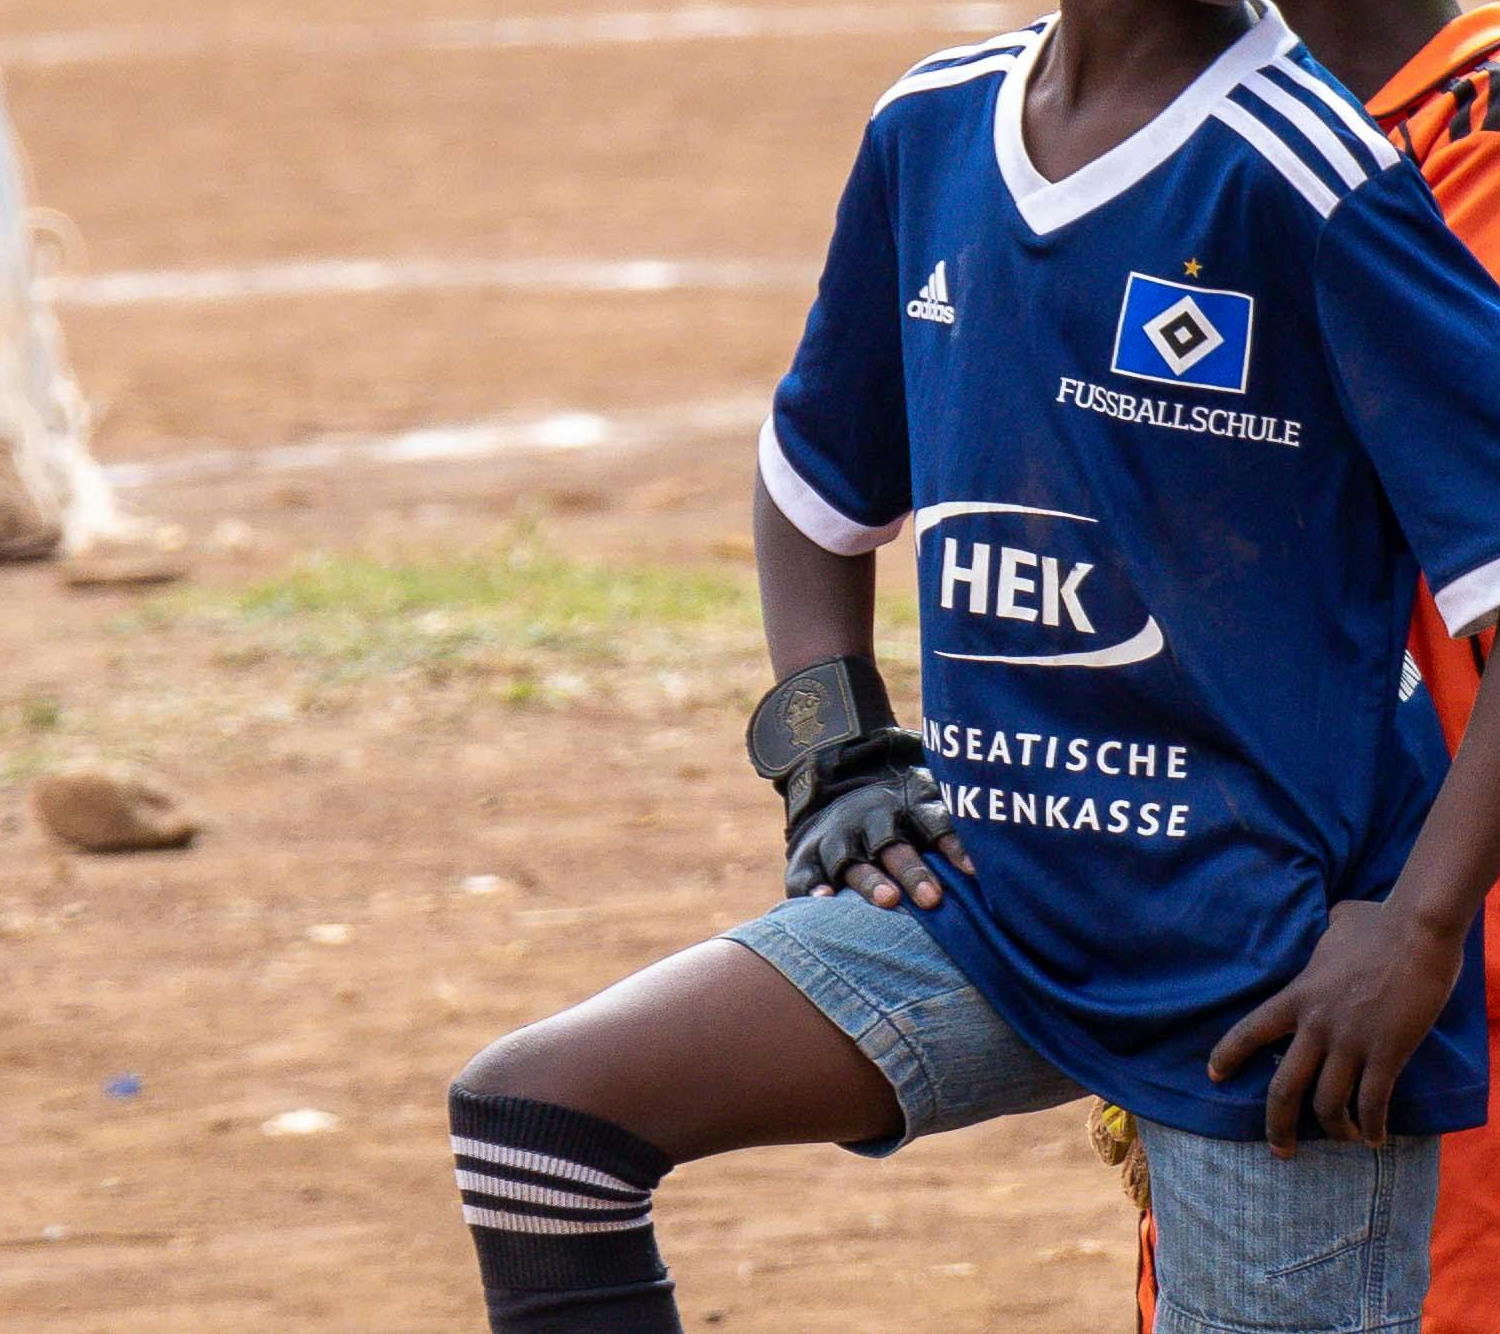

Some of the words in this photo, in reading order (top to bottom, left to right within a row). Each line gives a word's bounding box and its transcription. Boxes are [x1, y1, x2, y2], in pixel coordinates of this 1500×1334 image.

[906, 299, 955, 325] adidas
[1056, 376, 1302, 447] FUSSBALLSCHULE
[940, 536, 1097, 635] HEK
